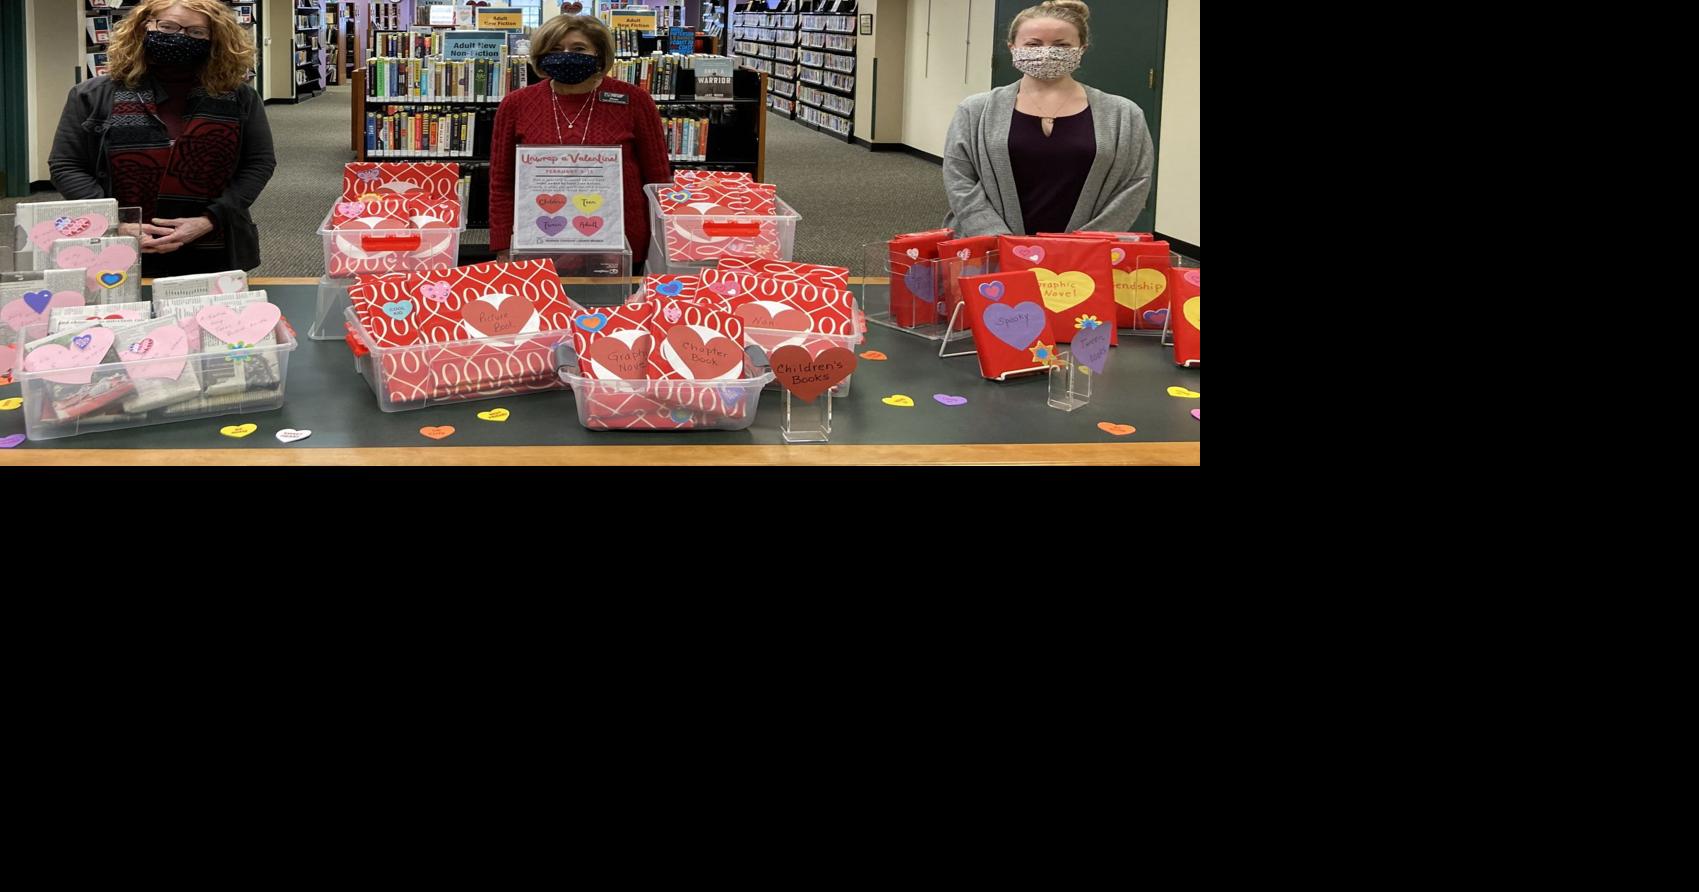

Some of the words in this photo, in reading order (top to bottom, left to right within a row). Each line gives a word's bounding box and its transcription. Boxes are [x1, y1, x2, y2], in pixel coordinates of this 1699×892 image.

[453, 42, 476, 50] Adult
[521, 154, 558, 165] Unwrap
[568, 153, 618, 164] Valentine!
[581, 199, 597, 207] Teen
[1039, 282, 1076, 290] raphic
[1117, 282, 1162, 292] endship
[1044, 288, 1077, 298] Novel
[479, 311, 509, 322] Picture
[995, 312, 1030, 328] Spooky
[682, 342, 728, 358] Chapter
[691, 353, 718, 366] Book
[619, 362, 647, 373] Nove
[776, 361, 843, 374] Children's
[791, 374, 830, 385] Books
